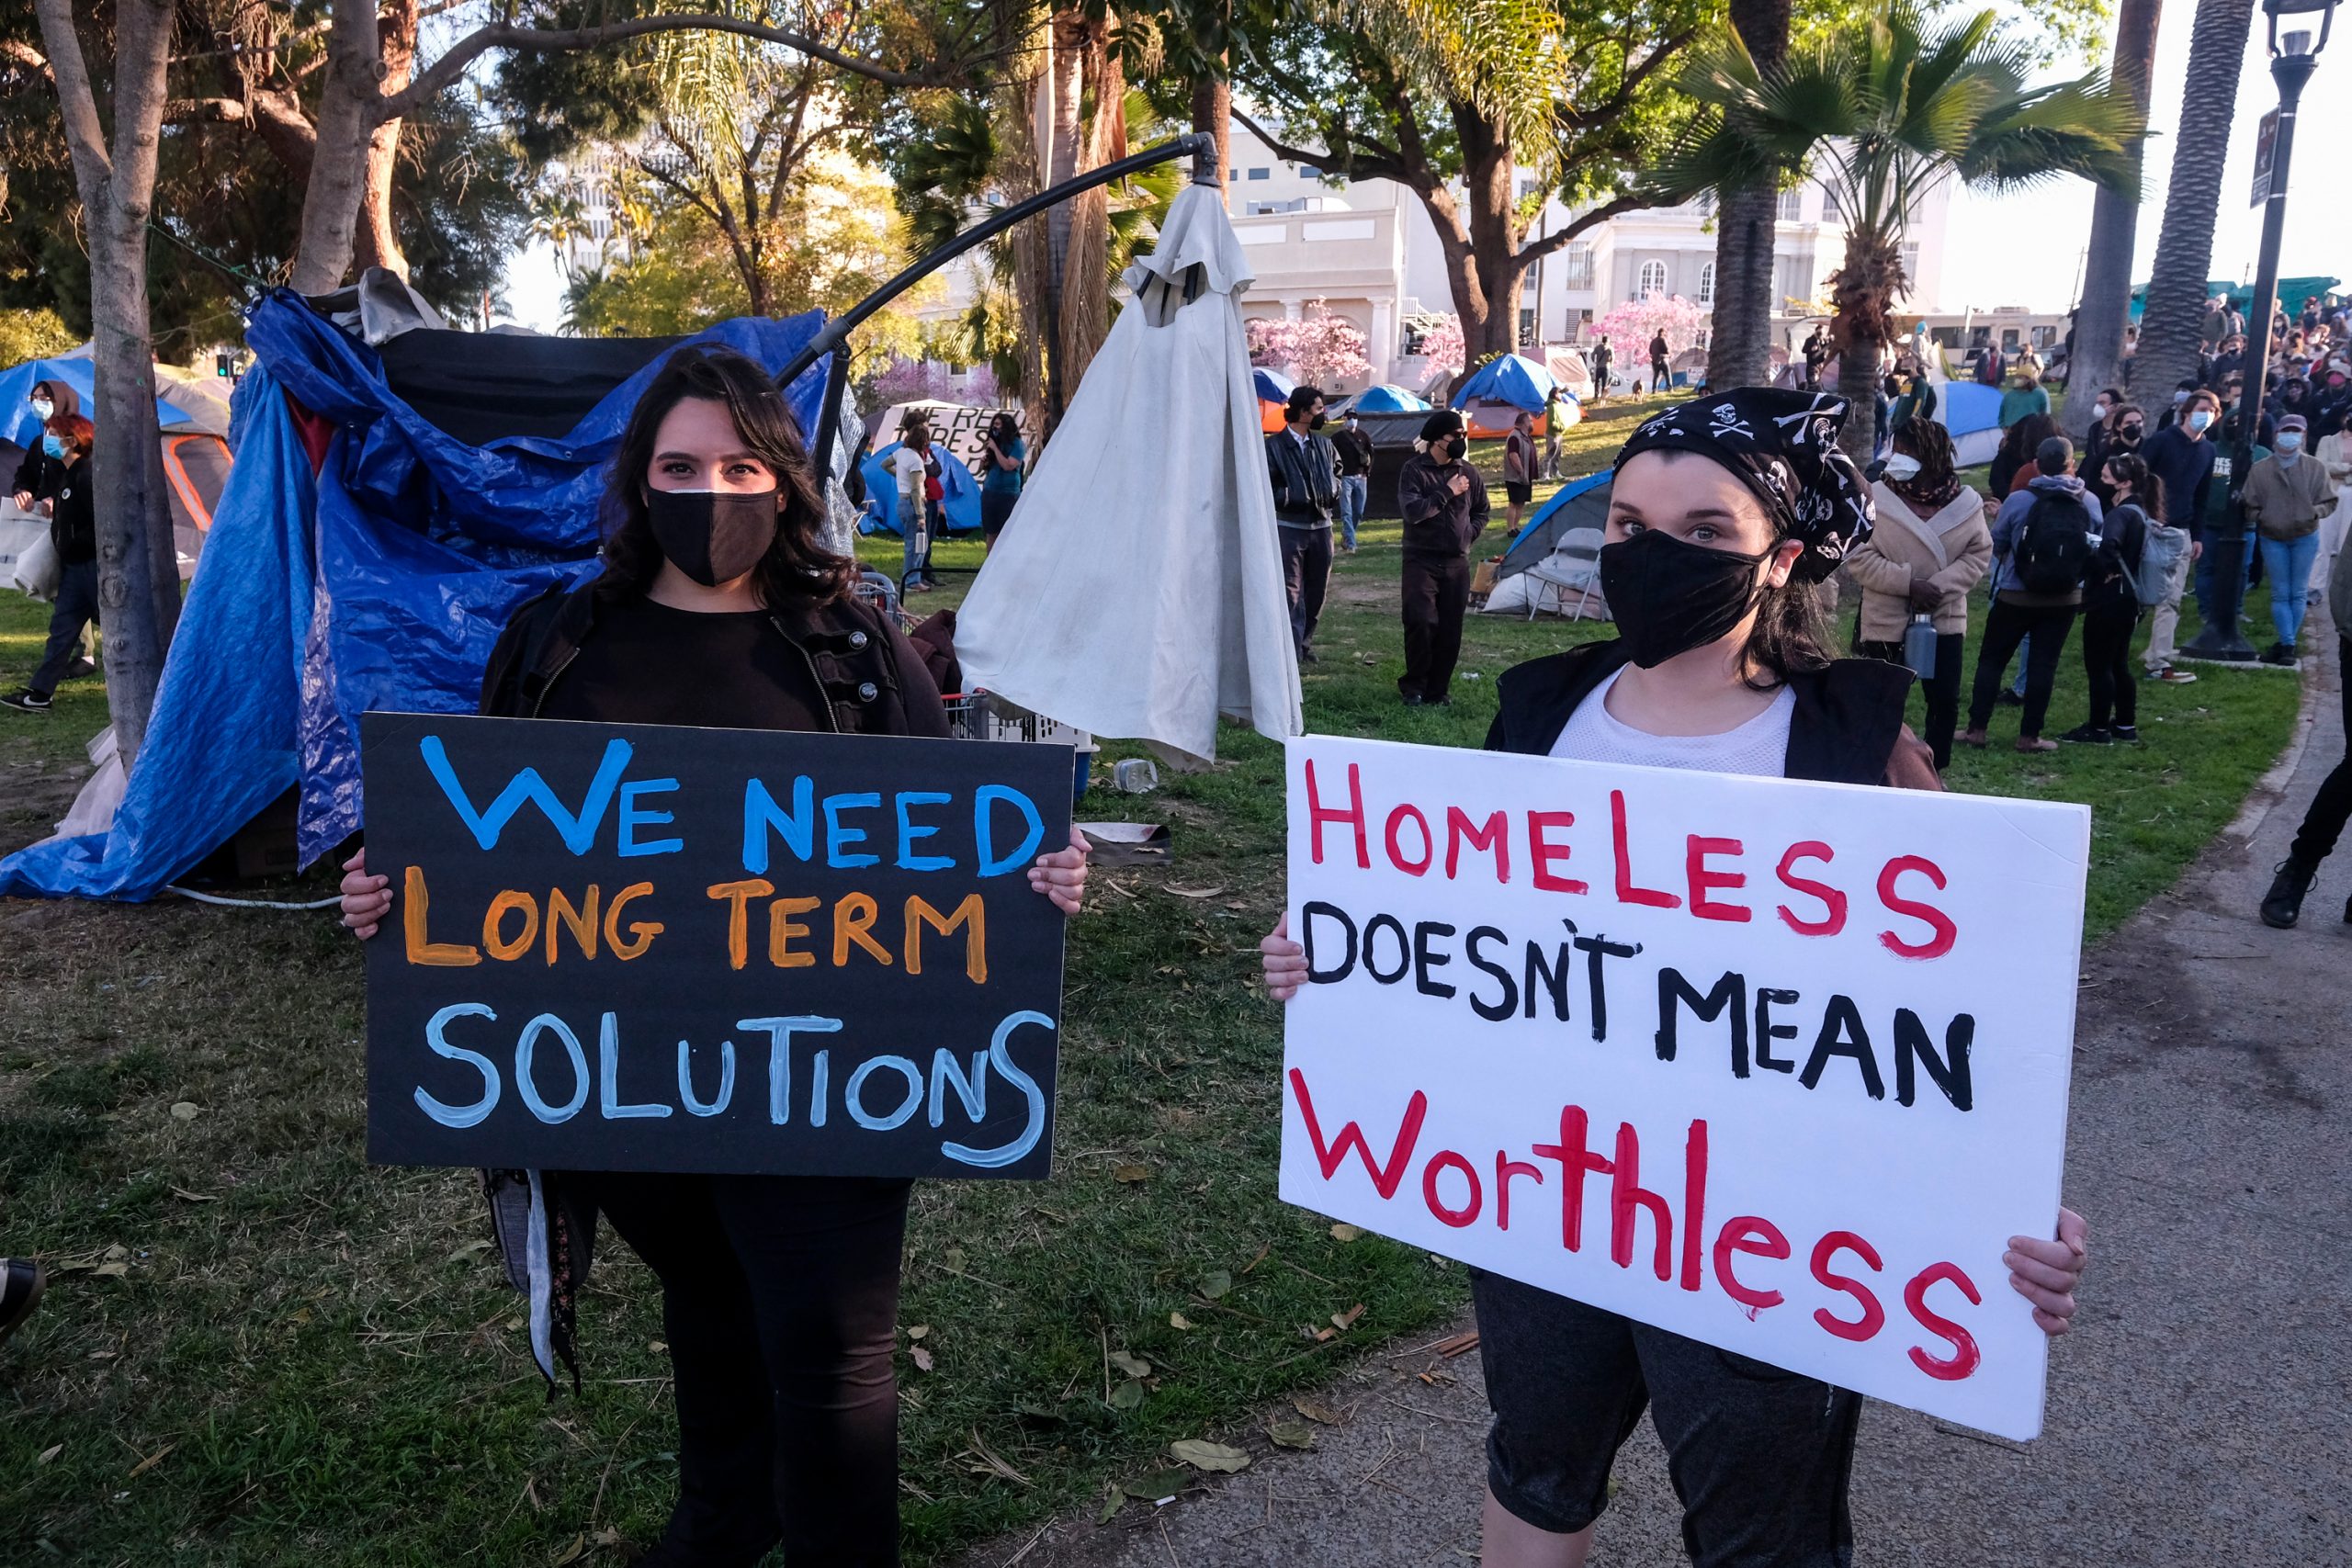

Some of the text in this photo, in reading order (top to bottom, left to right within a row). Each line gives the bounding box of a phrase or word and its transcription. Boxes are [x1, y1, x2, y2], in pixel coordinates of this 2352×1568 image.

[419, 735, 1046, 879] WE NEED
[1305, 758, 1958, 962] HOMELESS
[404, 865, 988, 985] LONG TERM
[1302, 901, 1976, 1112] DOESN'T MEAN
[413, 1002, 1056, 1168] SOLUTIONS
[1288, 1067, 1983, 1382] Worthless
